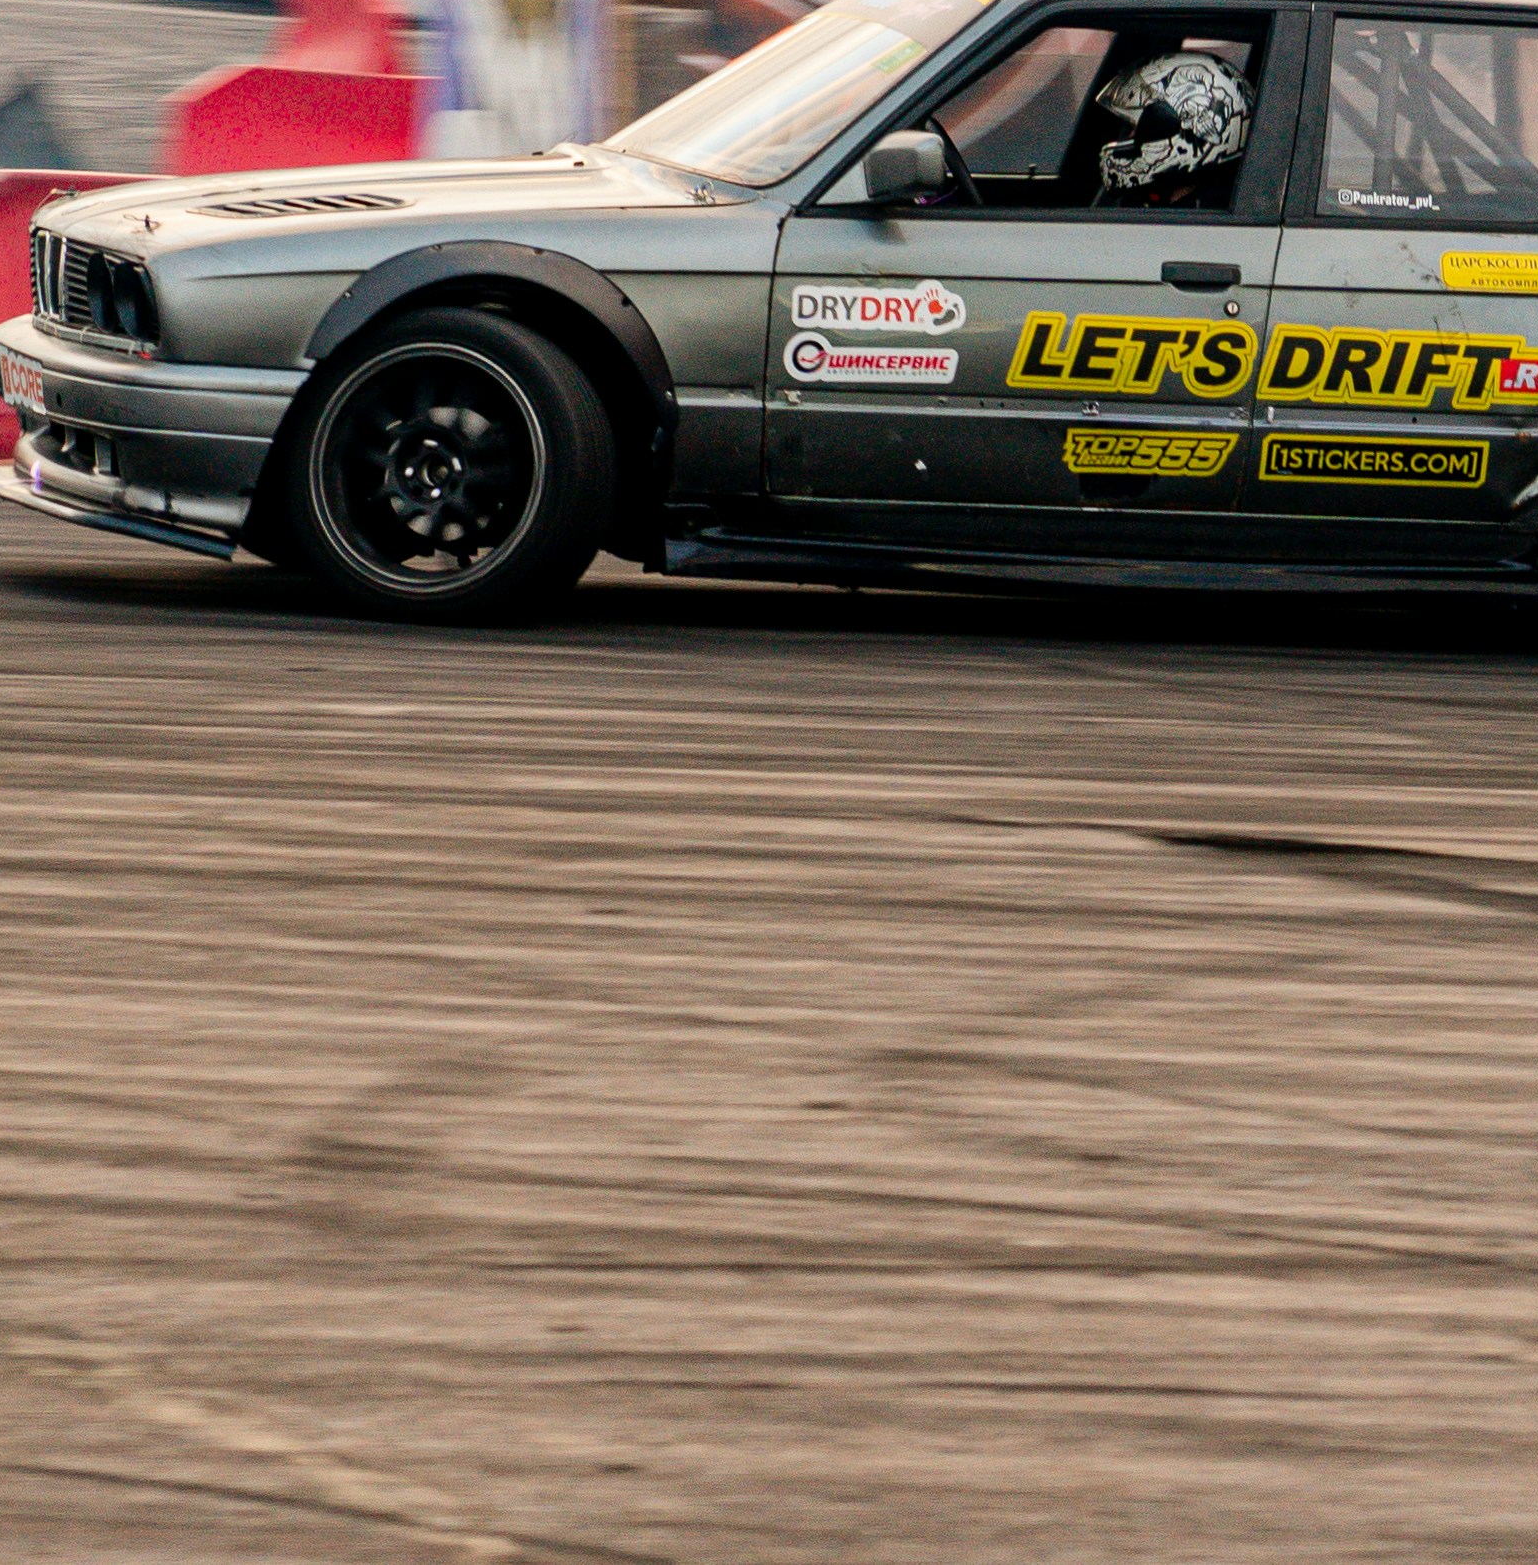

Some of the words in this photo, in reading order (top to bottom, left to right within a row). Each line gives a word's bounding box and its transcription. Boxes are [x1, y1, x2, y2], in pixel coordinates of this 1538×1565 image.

[1353, 191, 1440, 210] Pankratov_pvl_
[828, 354, 951, 370] ШИНСЕРВИС
[1020, 323, 1249, 387] LET'S
